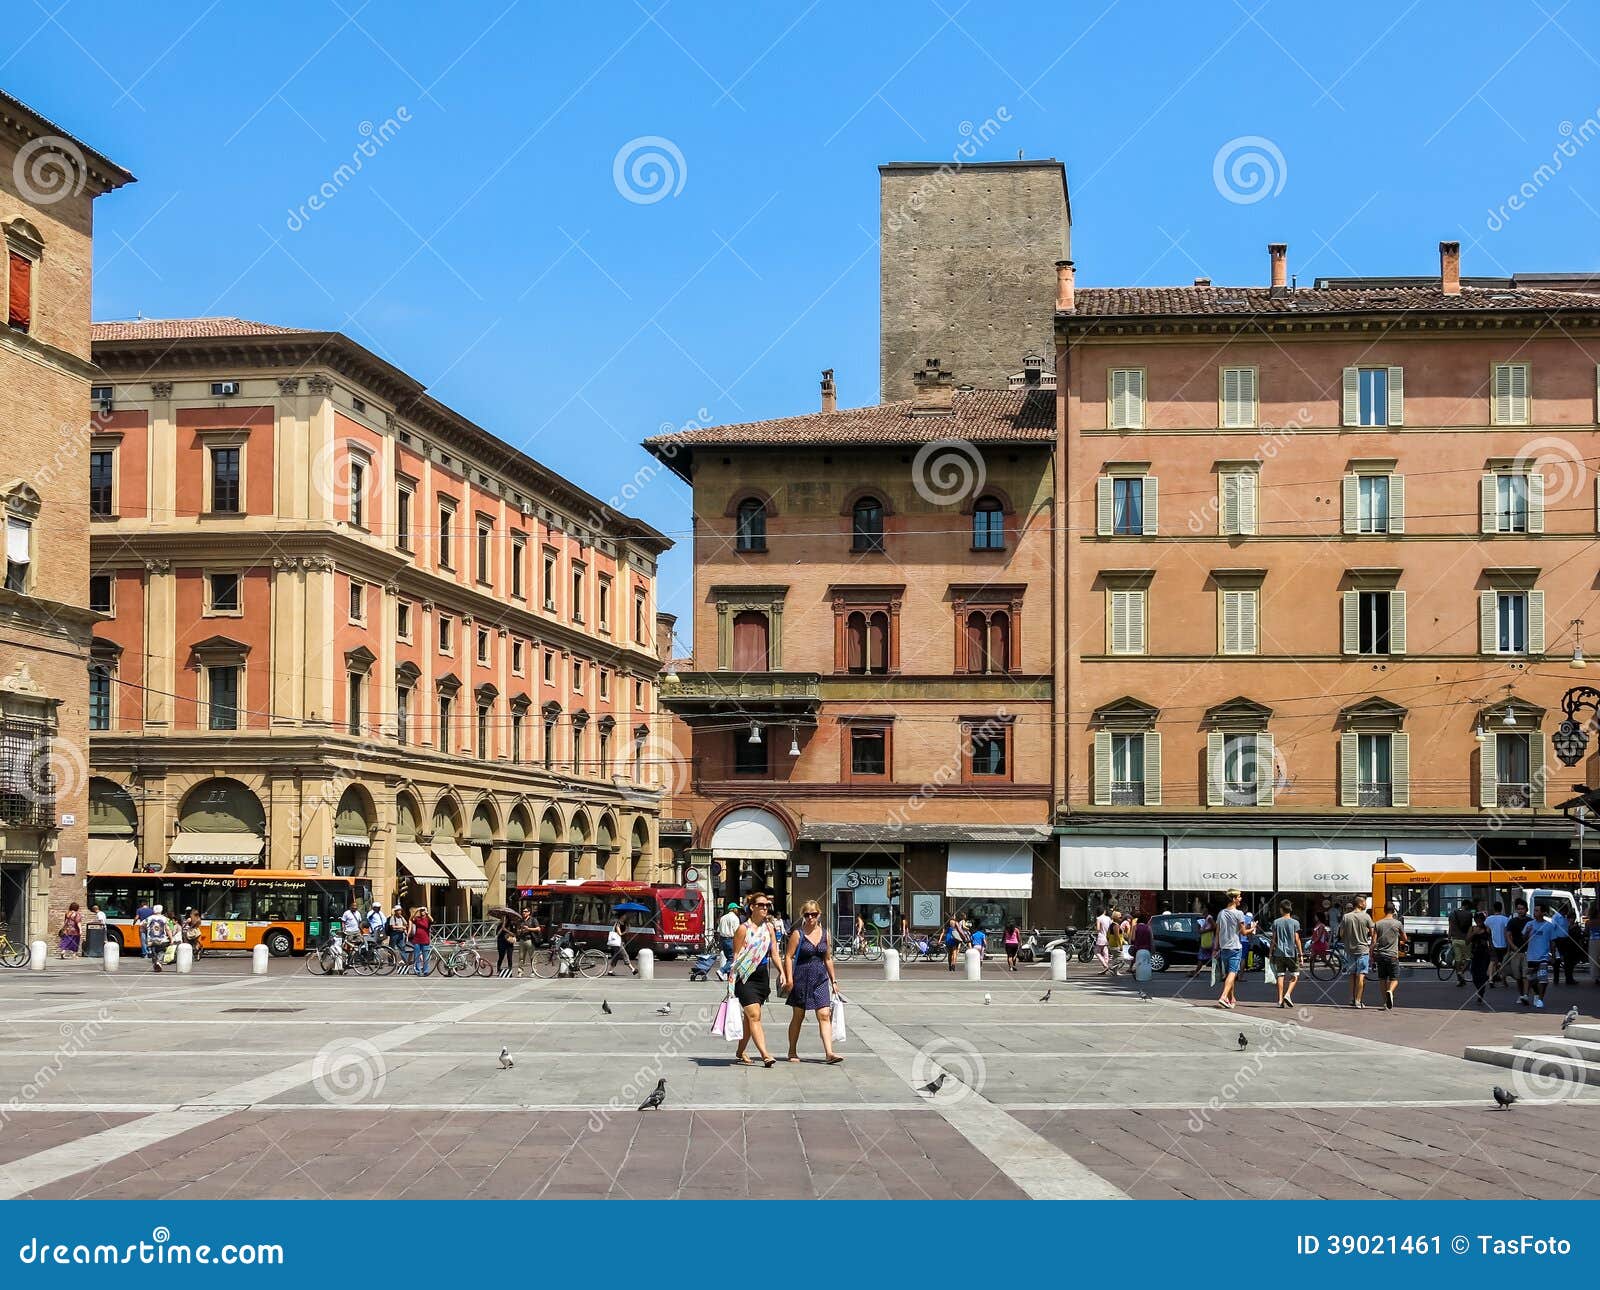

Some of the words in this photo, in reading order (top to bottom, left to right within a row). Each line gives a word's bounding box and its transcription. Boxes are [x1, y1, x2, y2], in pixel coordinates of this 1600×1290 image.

[848, 872, 860, 888] 3
[860, 876, 884, 886] Store
[1314, 873, 1350, 881] GEOX
[663, 933, 700, 942] www.tper.it
